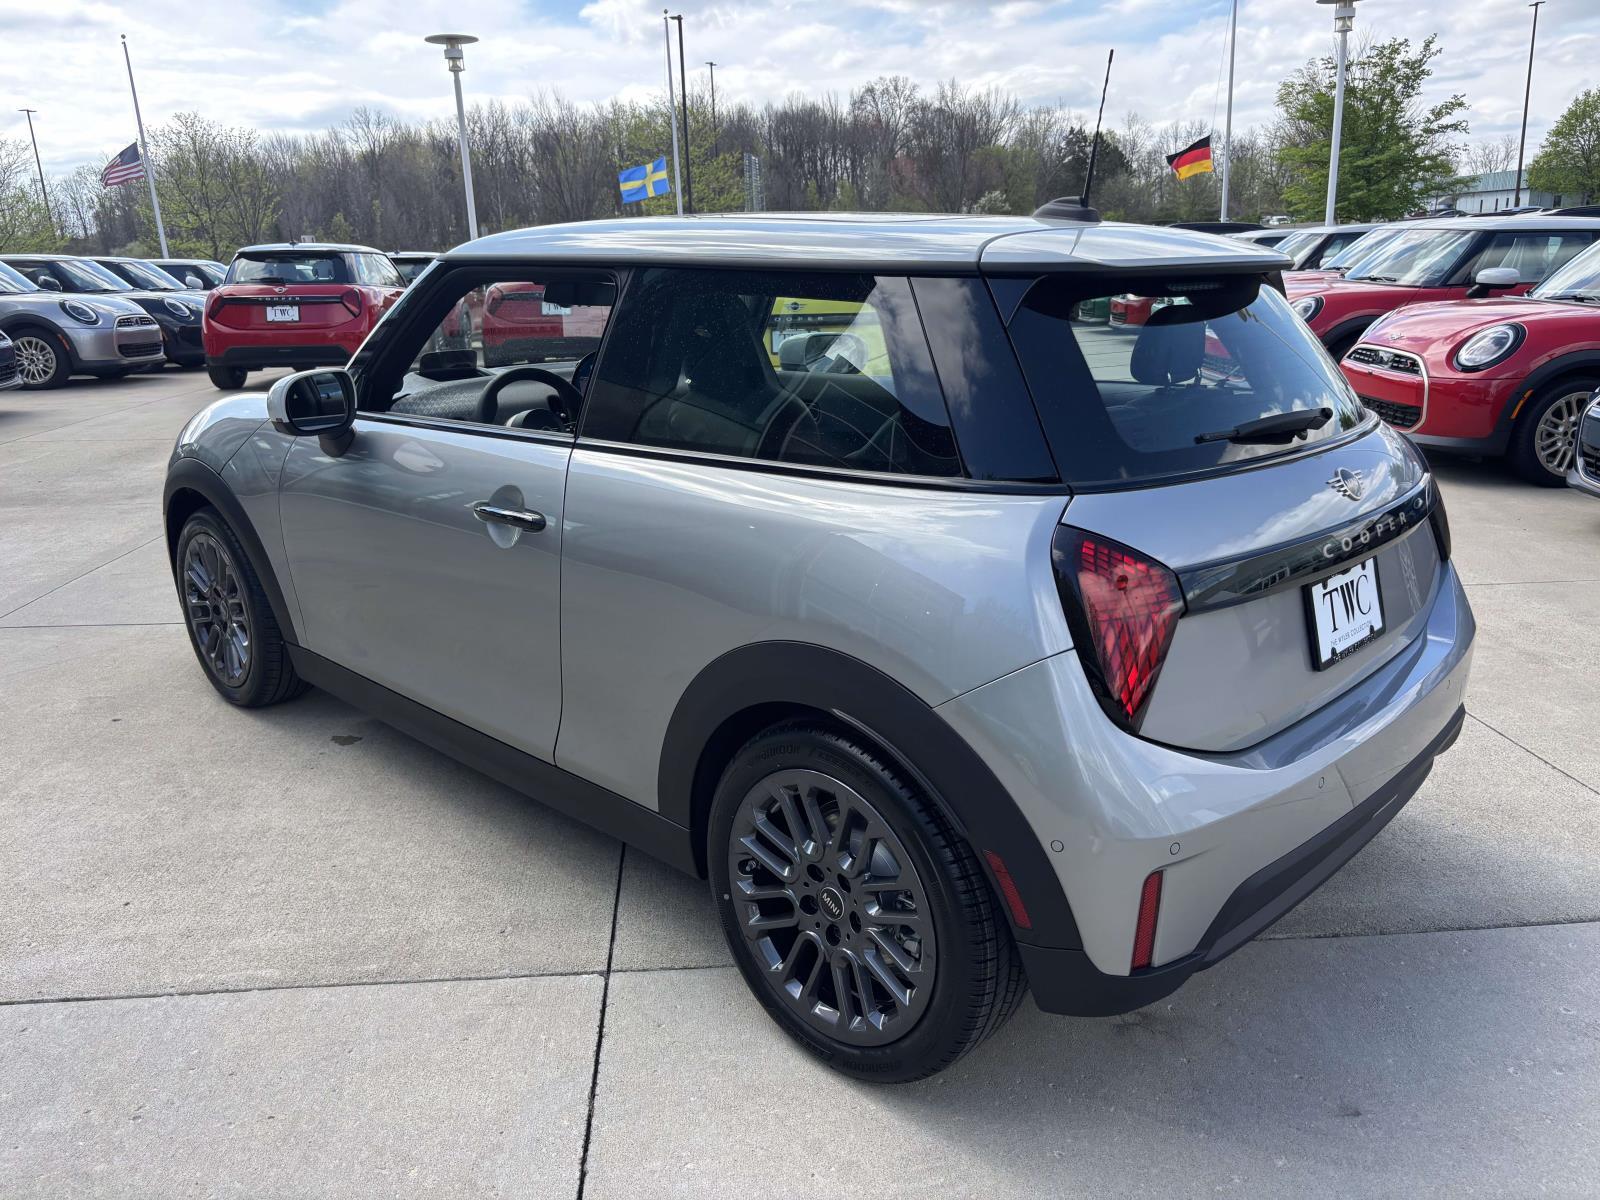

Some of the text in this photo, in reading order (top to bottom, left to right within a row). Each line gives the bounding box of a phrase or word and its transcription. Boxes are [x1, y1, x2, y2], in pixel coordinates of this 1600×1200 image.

[271, 308, 294, 317] TWC
[1322, 511, 1407, 559] COOPER
[1322, 574, 1372, 634] TWC
[822, 892, 840, 915] MINI
